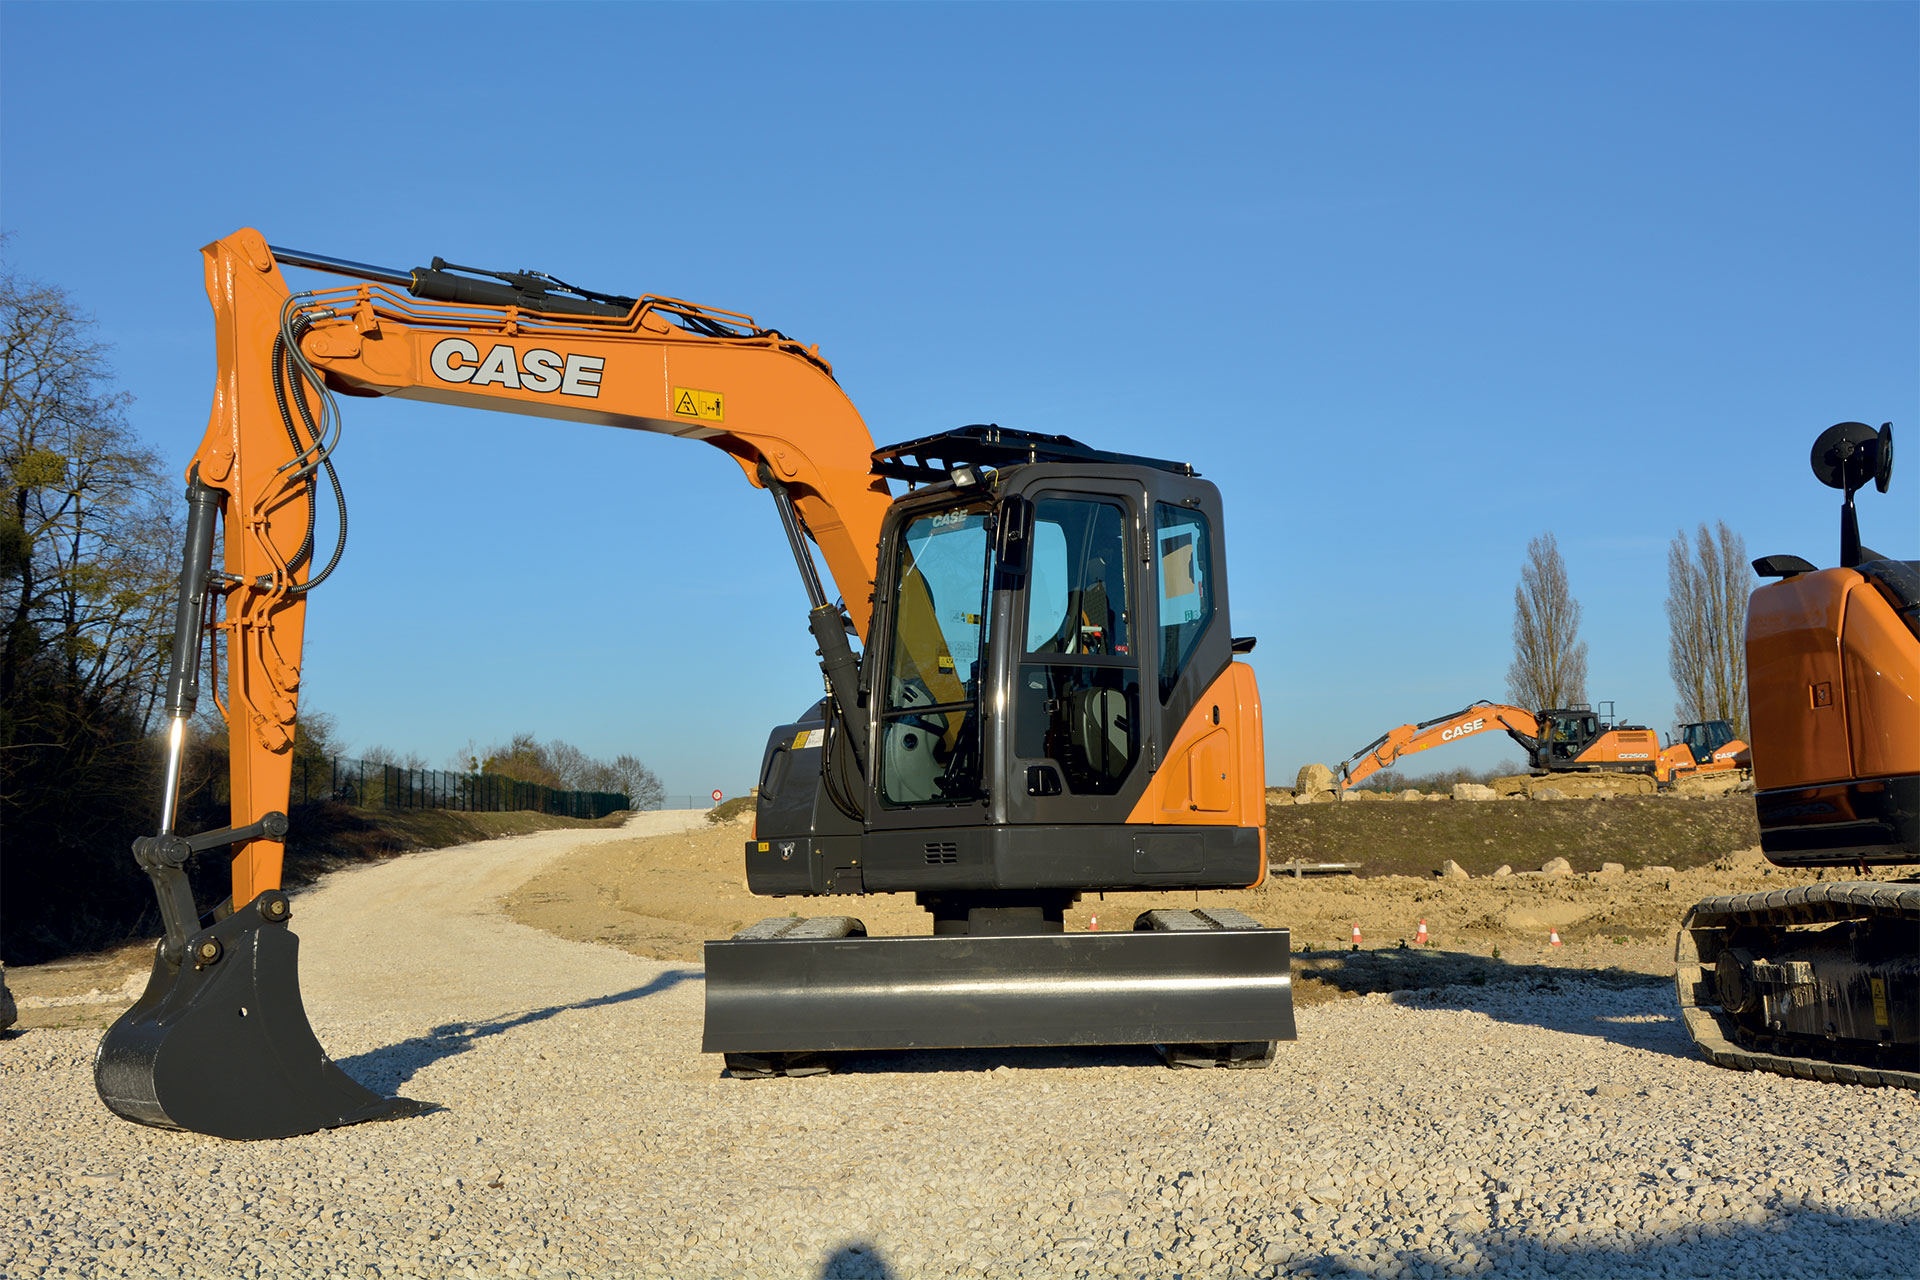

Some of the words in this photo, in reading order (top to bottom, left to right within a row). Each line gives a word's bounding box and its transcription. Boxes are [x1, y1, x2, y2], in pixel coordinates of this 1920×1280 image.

[431, 338, 606, 398] CASE
[932, 509, 968, 528] CASE
[1441, 718, 1484, 741] CASE
